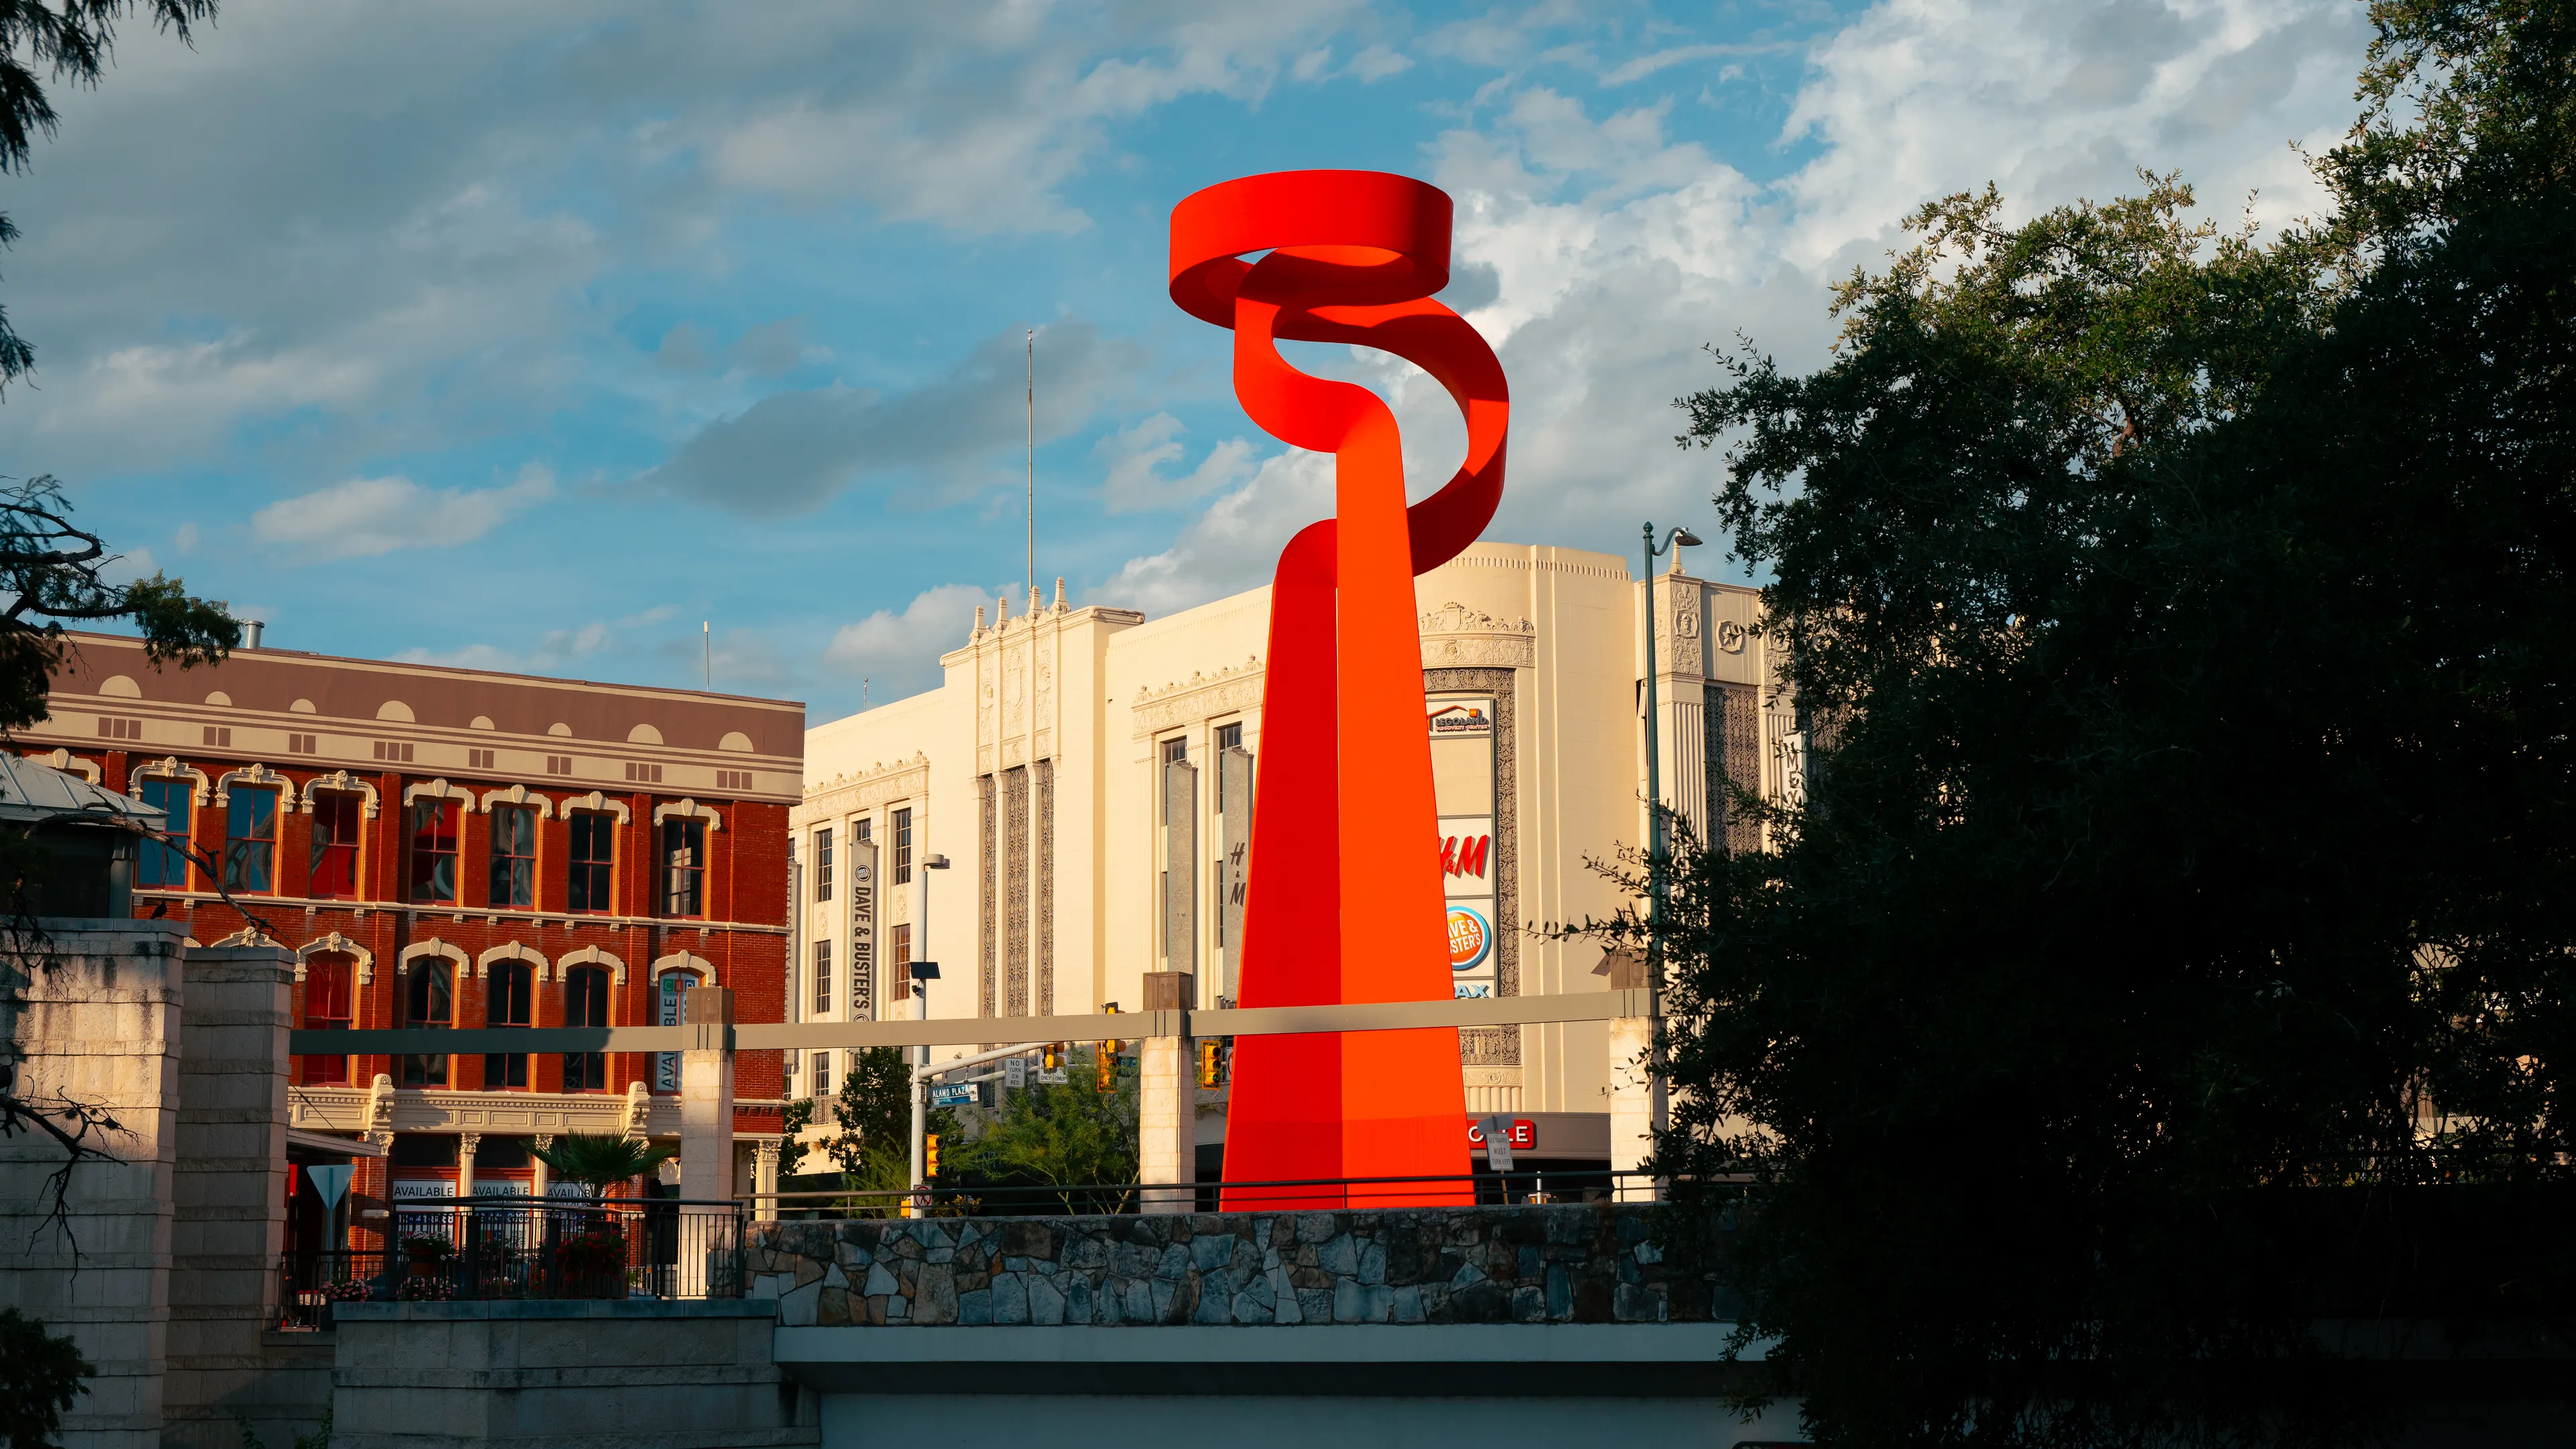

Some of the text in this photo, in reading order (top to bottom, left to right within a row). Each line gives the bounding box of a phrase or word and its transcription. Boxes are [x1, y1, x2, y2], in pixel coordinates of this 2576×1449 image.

[1436, 716, 1487, 726] LEGOLAND
[855, 886, 871, 923] DAVE
[854, 926, 870, 937] &
[1448, 919, 1479, 939] AVE &
[853, 943, 870, 1009] BUSTER'S
[1454, 984, 1489, 998] AX
[932, 1084, 969, 1098] ALAMO PLAZA
[394, 1186, 453, 1197] AVAILABLE
[472, 1186, 529, 1196] AVAILABLE
